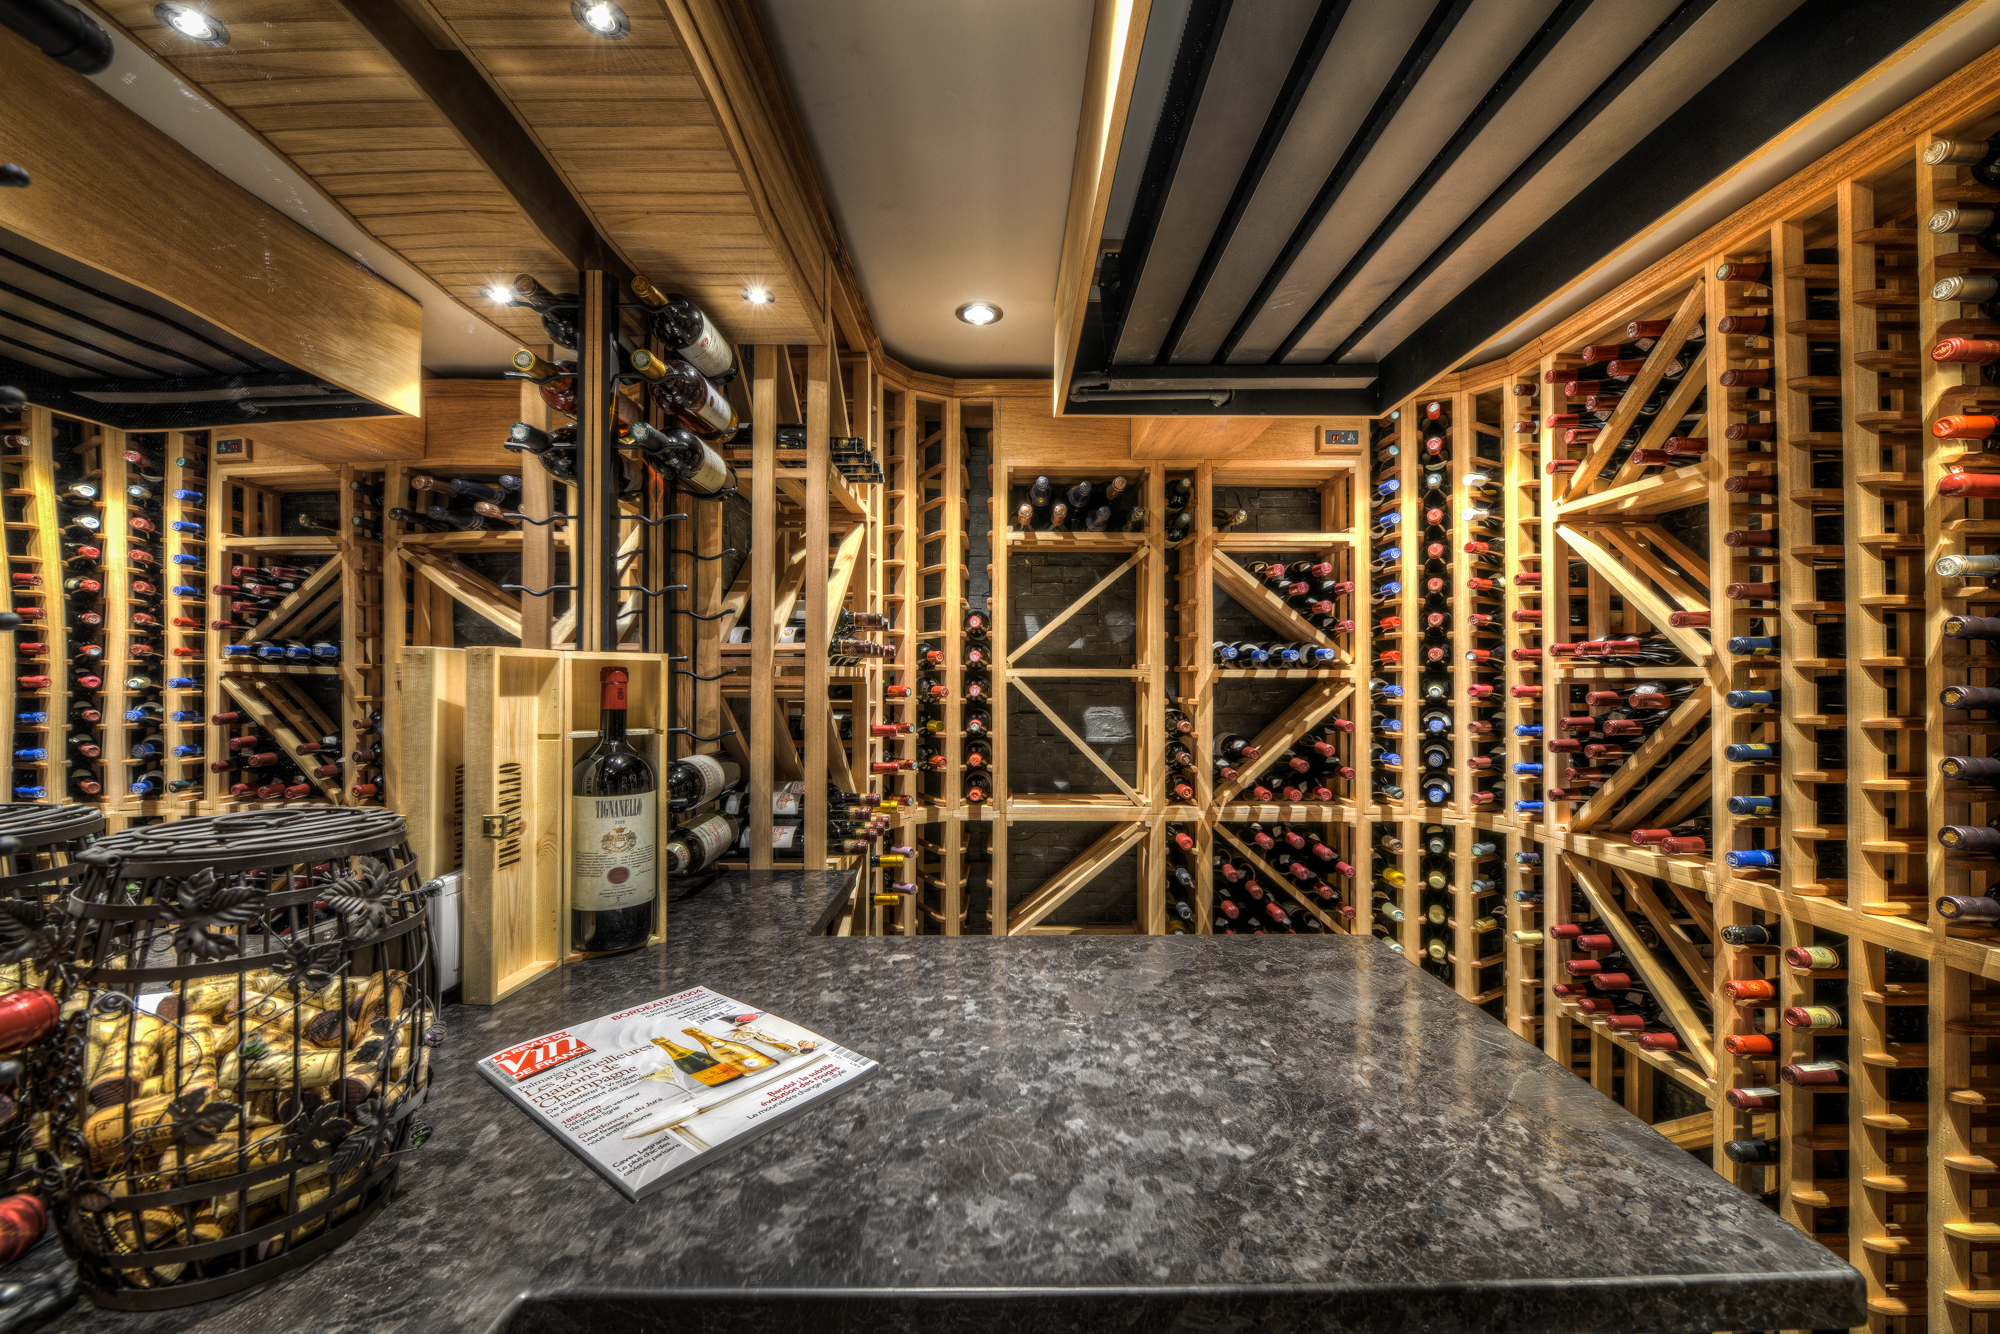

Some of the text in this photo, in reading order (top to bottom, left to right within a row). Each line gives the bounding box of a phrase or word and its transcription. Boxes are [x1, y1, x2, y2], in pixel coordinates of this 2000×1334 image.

[596, 798, 642, 818] TIGNANELLO
[611, 998, 676, 1020] BORDEAUX
[677, 989, 703, 1000] 2004
[492, 1032, 570, 1062] LA REVUE DU
[512, 1067, 534, 1080] DE
[534, 1046, 592, 1070] FRANCE
[517, 1070, 564, 1092] Palmarès
[565, 1059, 592, 1072] inédit
[522, 1044, 654, 1098] Les 50 meilleures
[532, 1071, 600, 1104] maisons
[601, 1062, 622, 1074] de
[539, 1066, 638, 1108] Champagne
[760, 1066, 840, 1106] évolution des rouges
[766, 1081, 796, 1097] Bandol
[808, 1063, 834, 1077] subtile
[545, 1106, 560, 1115] De
[560, 1088, 599, 1107] Roederer
[560, 1091, 606, 1114] classement
[619, 1072, 656, 1088] référence
[612, 1092, 640, 1108] vendeur
[746, 1112, 758, 1120] Le
[758, 1094, 798, 1114] mourvèdre
[798, 1082, 822, 1096] change
[831, 1069, 847, 1079] style
[562, 1104, 601, 1124] 1855.com
[578, 1112, 634, 1139] Chardonnays
[645, 1097, 663, 1108] Jura
[602, 1106, 620, 1116] ligne
[582, 1121, 625, 1142] Leur finesse
[587, 1112, 652, 1146] nous enthousiasme
[612, 1135, 670, 1168] Caves Legrand
[624, 1143, 682, 1176] cavistes parisiens
[628, 1156, 644, 1168] plus
[644, 1148, 658, 1158] chic
[658, 1142, 671, 1150] des
